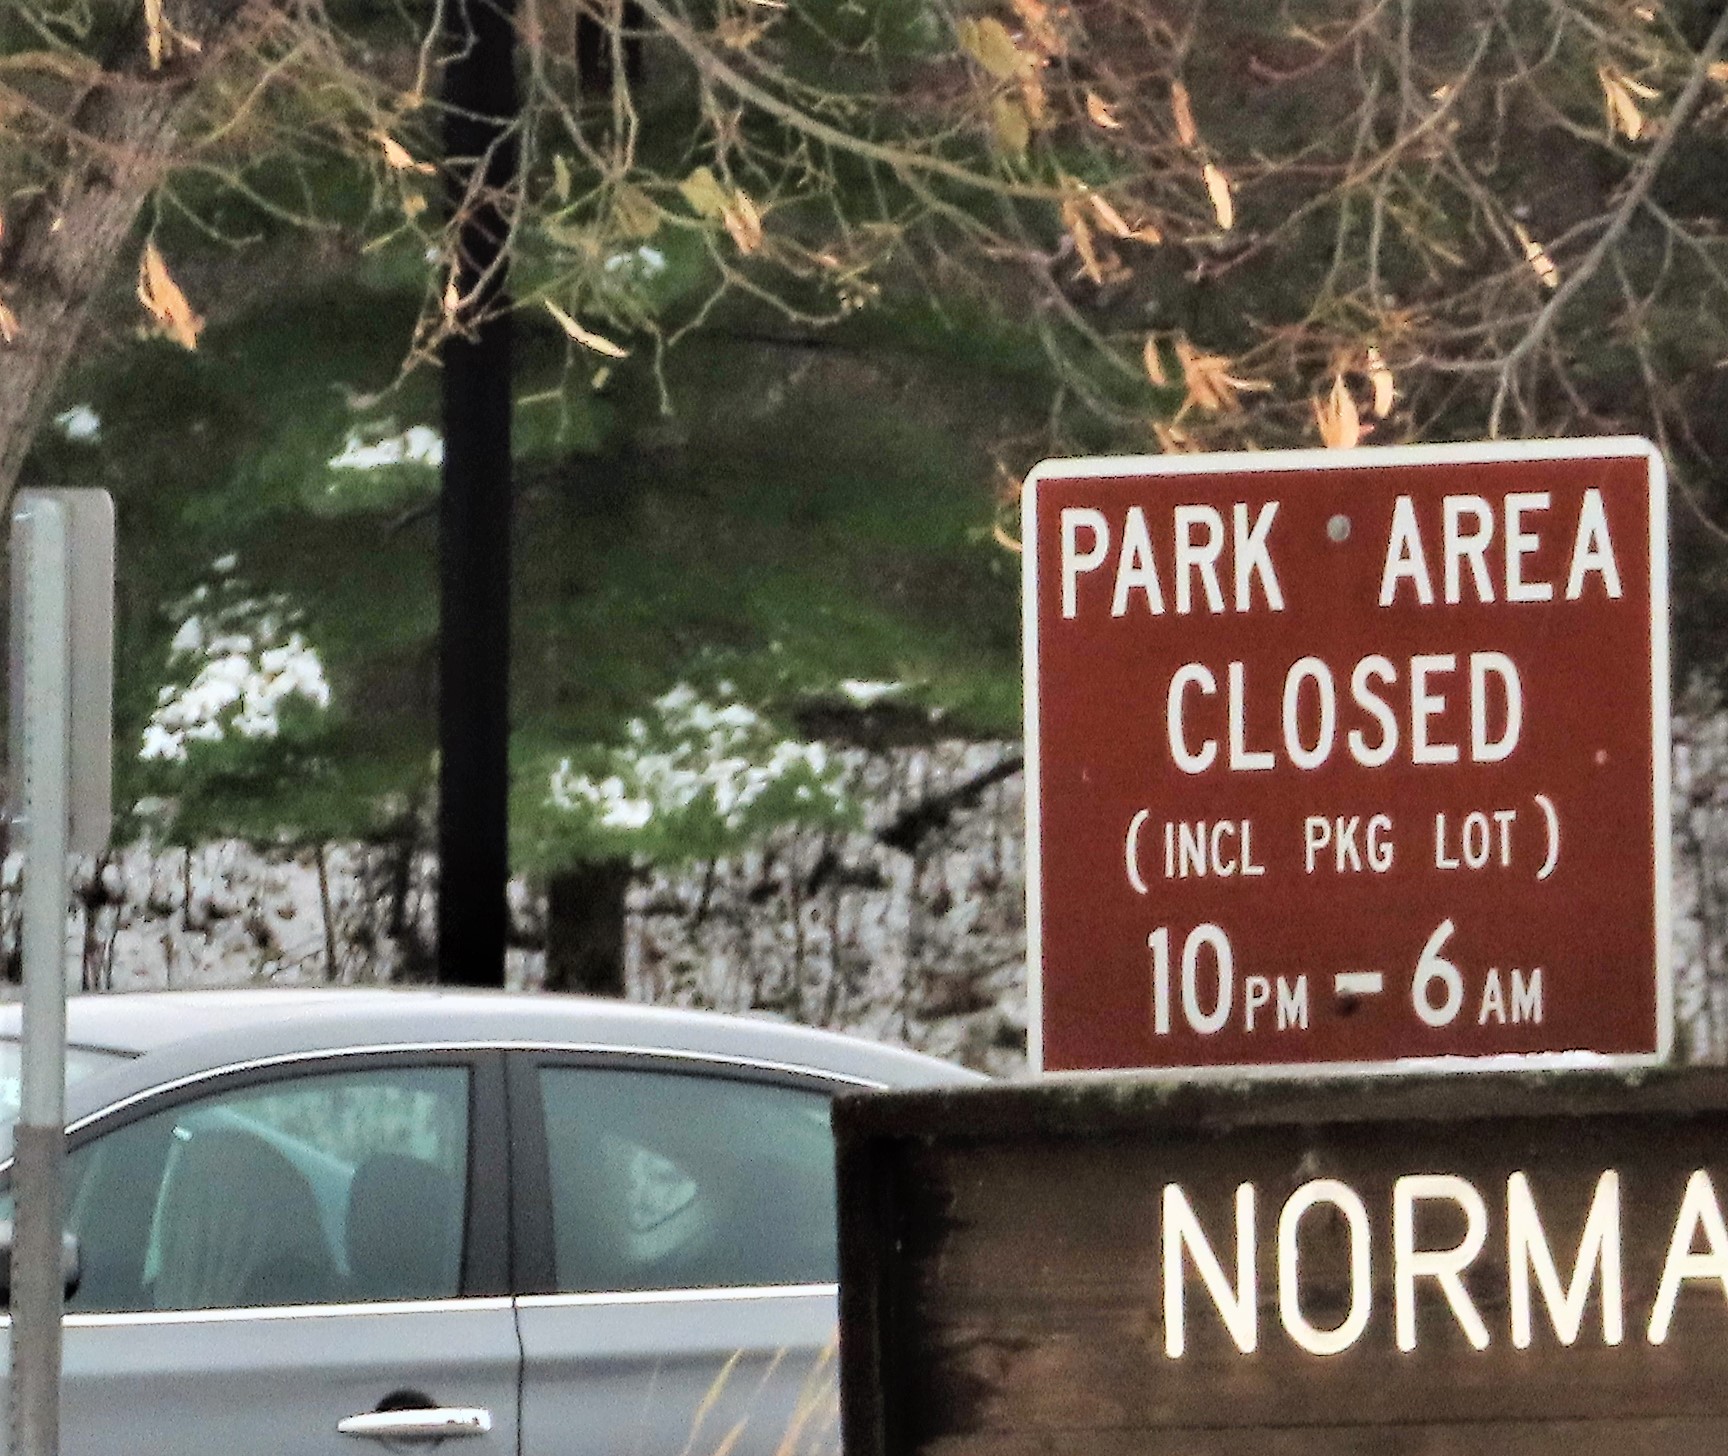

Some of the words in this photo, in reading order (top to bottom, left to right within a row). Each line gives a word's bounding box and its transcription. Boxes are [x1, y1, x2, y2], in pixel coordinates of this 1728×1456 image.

[1059, 500, 1286, 621] PARK
[1377, 487, 1624, 608] AREA
[1165, 650, 1524, 775] CLOSED
[1303, 812, 1395, 875] PKG
